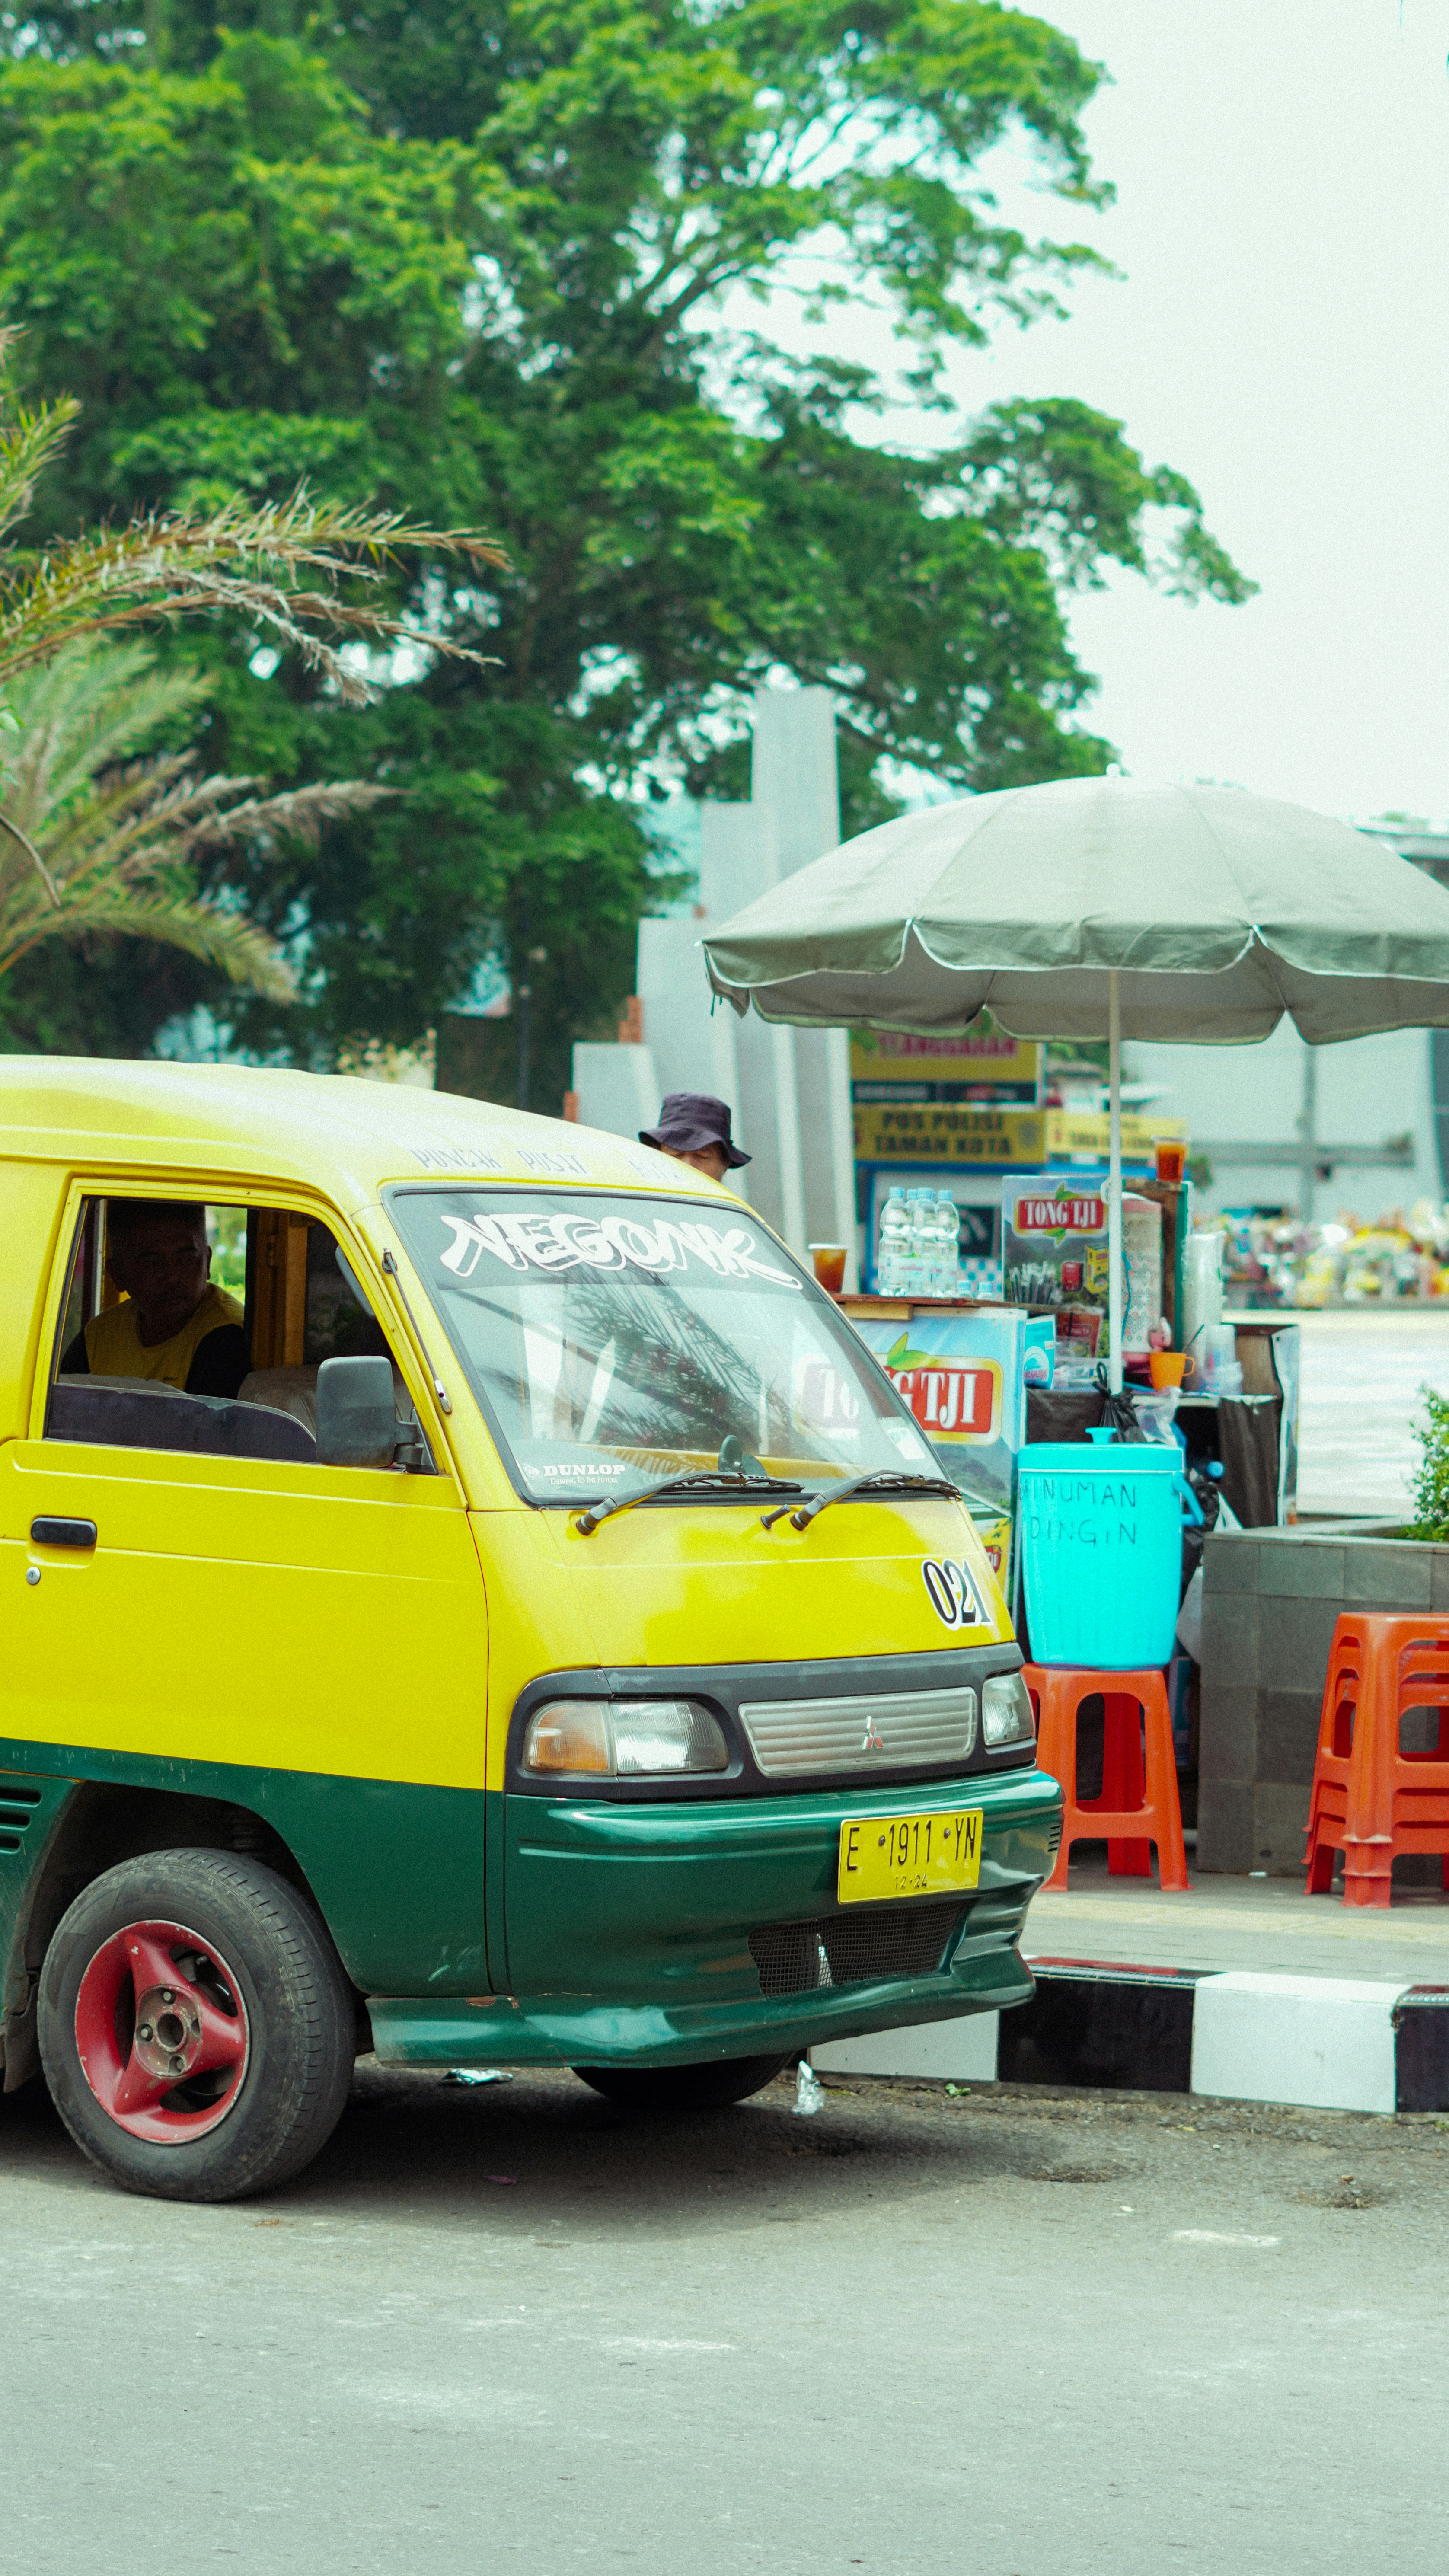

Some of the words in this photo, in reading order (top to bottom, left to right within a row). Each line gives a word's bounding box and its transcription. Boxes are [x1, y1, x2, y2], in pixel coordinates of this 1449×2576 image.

[882, 1111, 924, 1131] POS
[932, 1112, 1003, 1132] POLISI
[875, 1136, 948, 1154] TAMAN
[956, 1137, 1012, 1156] KOTA
[1024, 1201, 1068, 1226] TONG
[1071, 1201, 1096, 1228] TJI
[818, 1367, 913, 1420] TOG
[920, 1371, 977, 1429] TJI
[543, 1464, 626, 1477] DUNLOP
[922, 1559, 992, 1625] 021
[847, 1826, 860, 1871] E
[889, 1819, 932, 1867] 1911
[955, 1816, 977, 1861] YN
